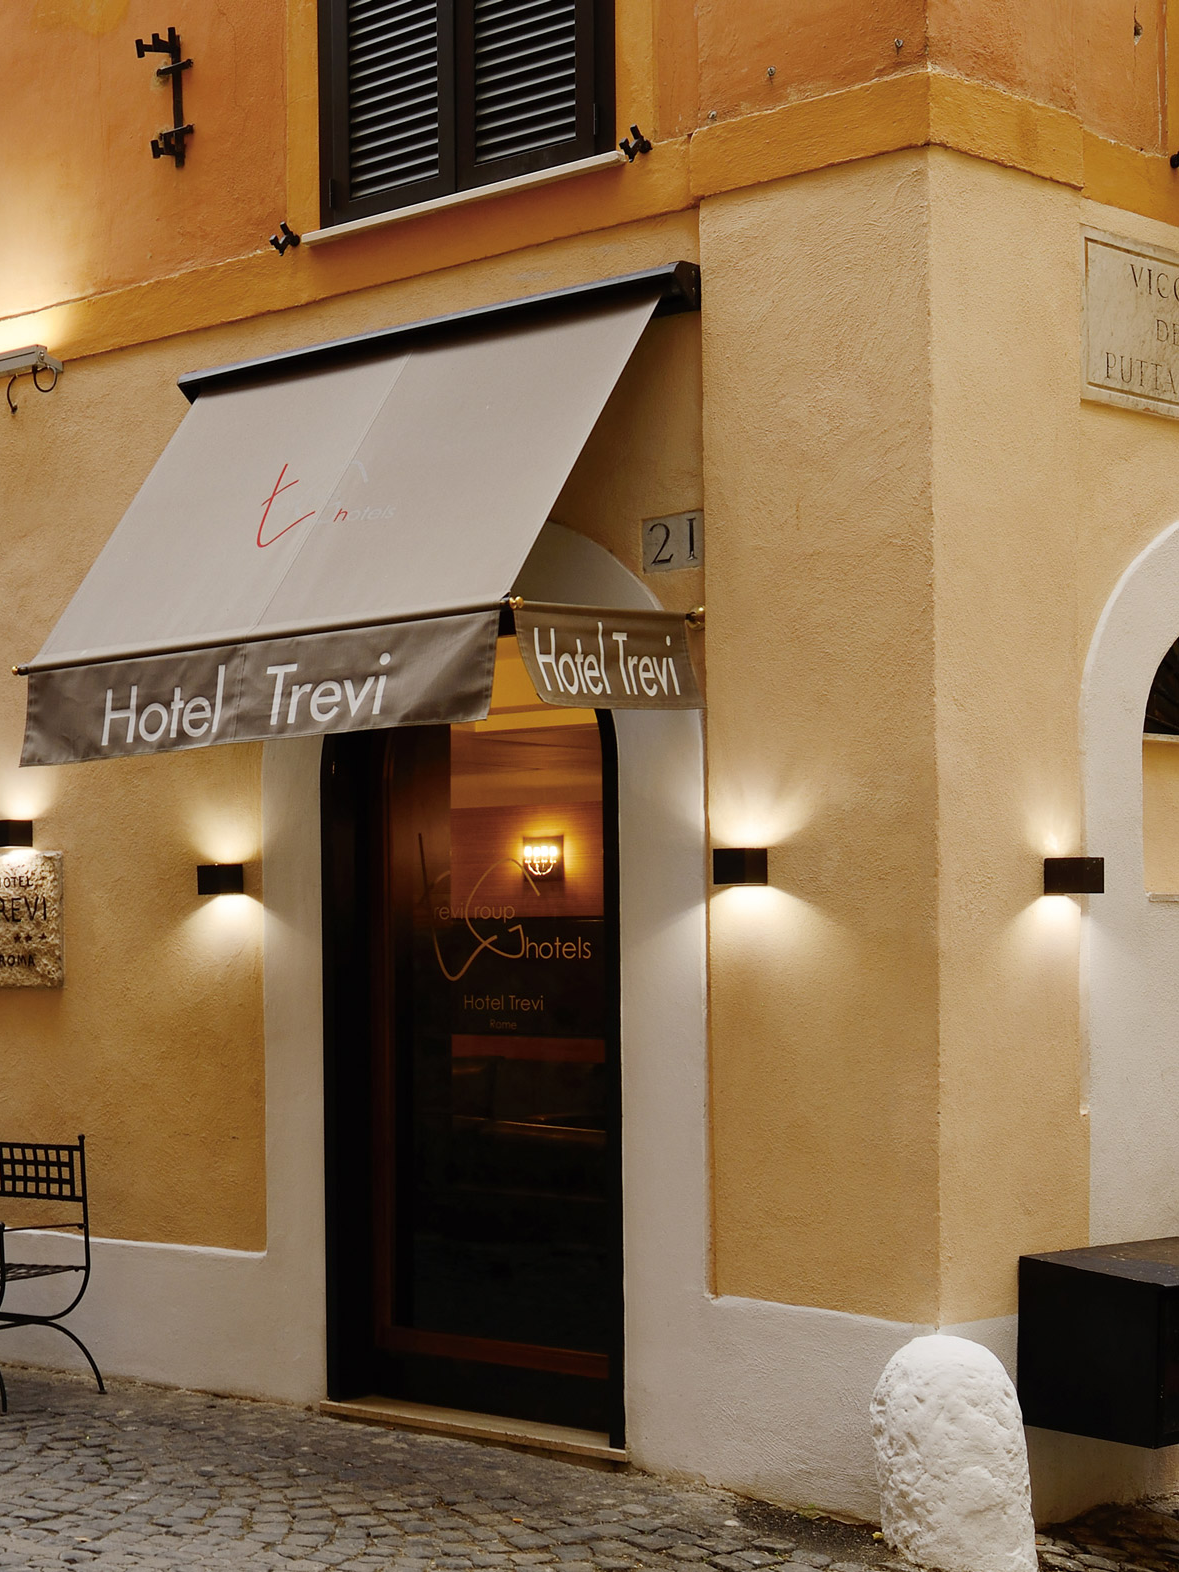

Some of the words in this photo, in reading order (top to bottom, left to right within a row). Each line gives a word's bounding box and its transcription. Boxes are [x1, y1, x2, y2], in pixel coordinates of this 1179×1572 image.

[647, 517, 698, 566] 21
[533, 621, 612, 696] Hotel
[612, 631, 681, 697] Trevi
[101, 664, 226, 746] Hotel
[266, 652, 392, 726] Trevi
[525, 936, 592, 960] hotels
[464, 994, 505, 1012] Hotel
[508, 994, 545, 1013] Trevi
